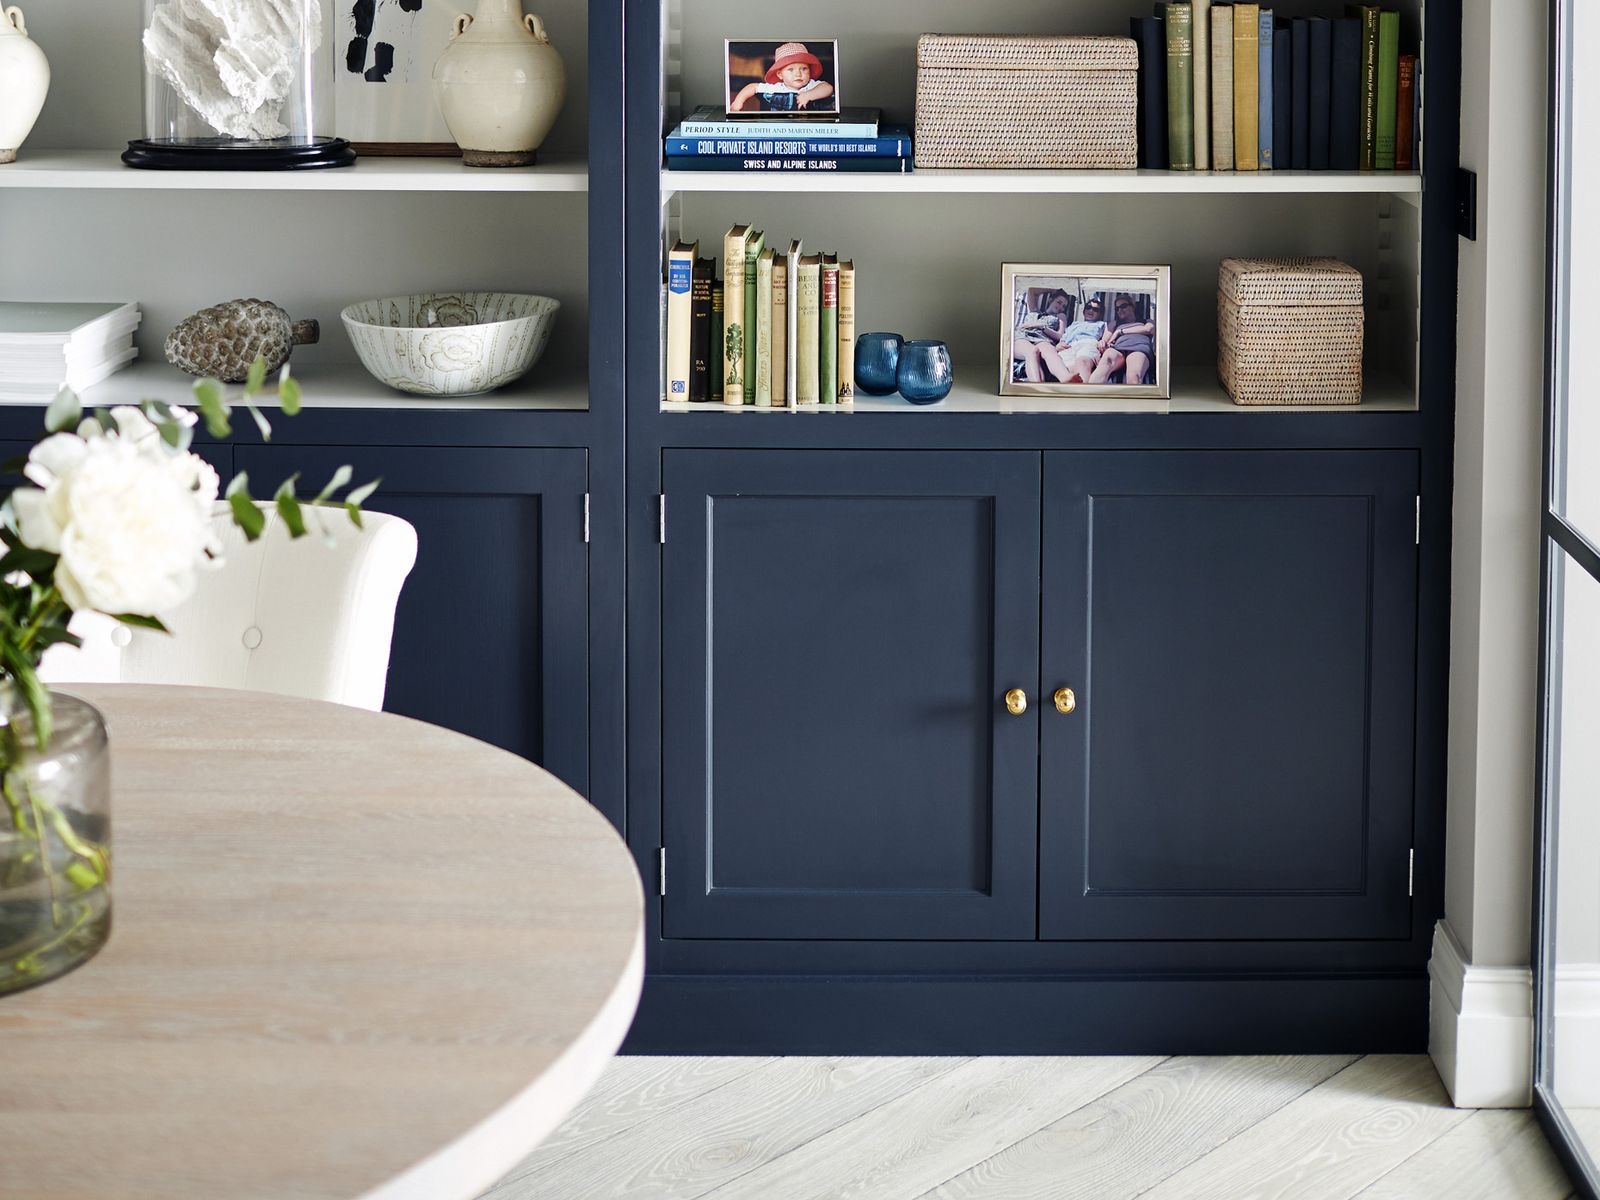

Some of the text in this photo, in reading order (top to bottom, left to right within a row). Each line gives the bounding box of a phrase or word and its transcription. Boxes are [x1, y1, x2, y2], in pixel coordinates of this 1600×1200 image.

[698, 140, 716, 154] COOL
[717, 140, 746, 154] PRIVATE
[748, 140, 773, 154] ISLAND
[774, 141, 806, 154] RESORTS
[809, 144, 817, 152] THE
[818, 144, 838, 152] WORLD'S
[846, 144, 856, 152] BEST
[858, 144, 876, 152] ISLANDS
[744, 160, 837, 169] SWISS AND ALPINE ISLANDS
